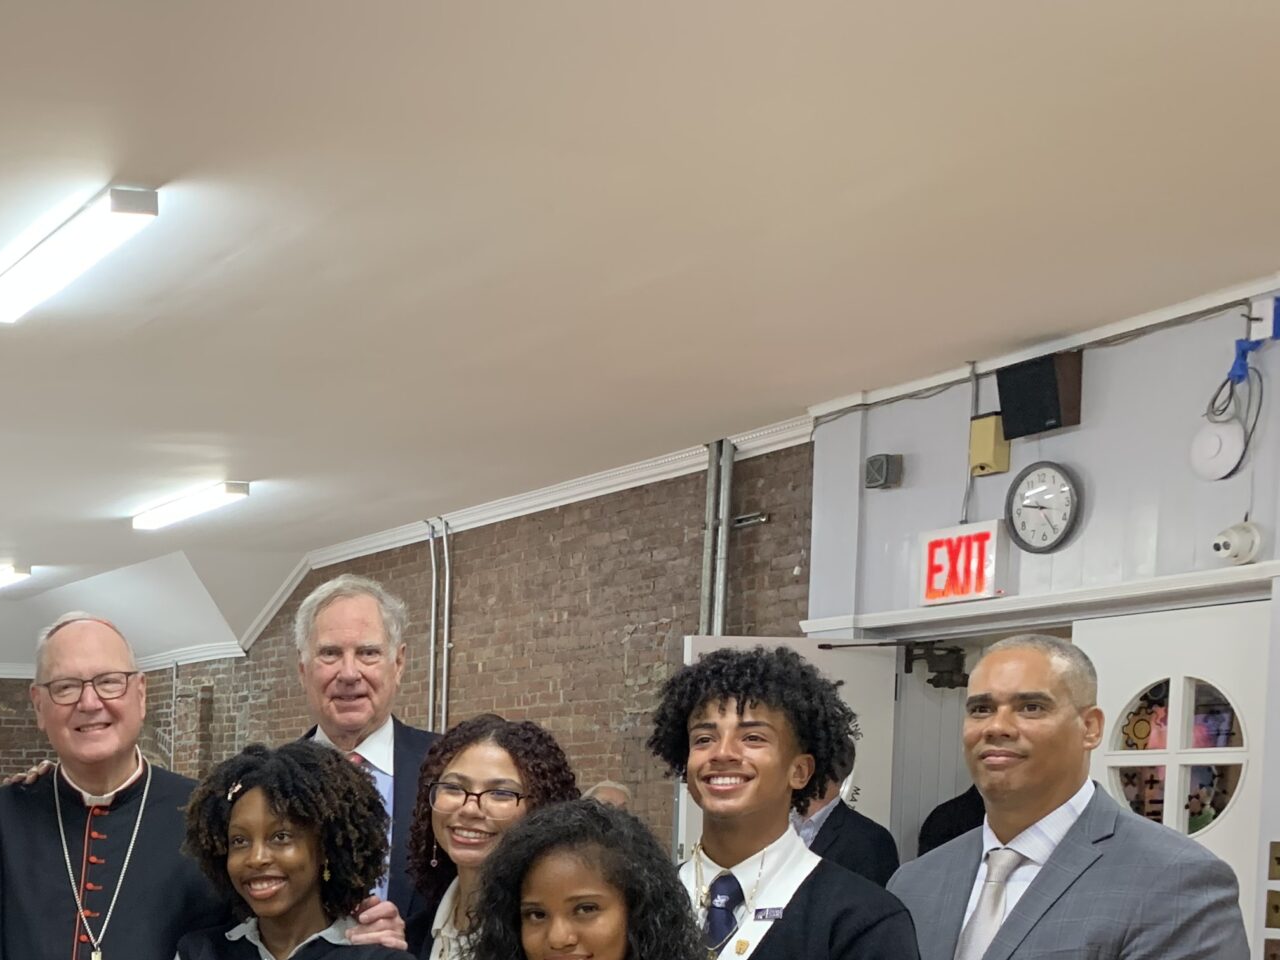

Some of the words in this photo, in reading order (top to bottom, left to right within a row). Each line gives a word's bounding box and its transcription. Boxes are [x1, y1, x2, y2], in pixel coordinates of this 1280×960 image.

[1037, 473, 1046, 483] 12
[1051, 475, 1056, 484] 1
[1027, 480, 1034, 488] 11
[1016, 508, 1022, 518] 9
[1061, 512, 1067, 521] 4
[1021, 521, 1027, 531] 8
[1030, 530, 1036, 540] 7
[1041, 531, 1048, 541] 6
[925, 530, 991, 600] EXIT
